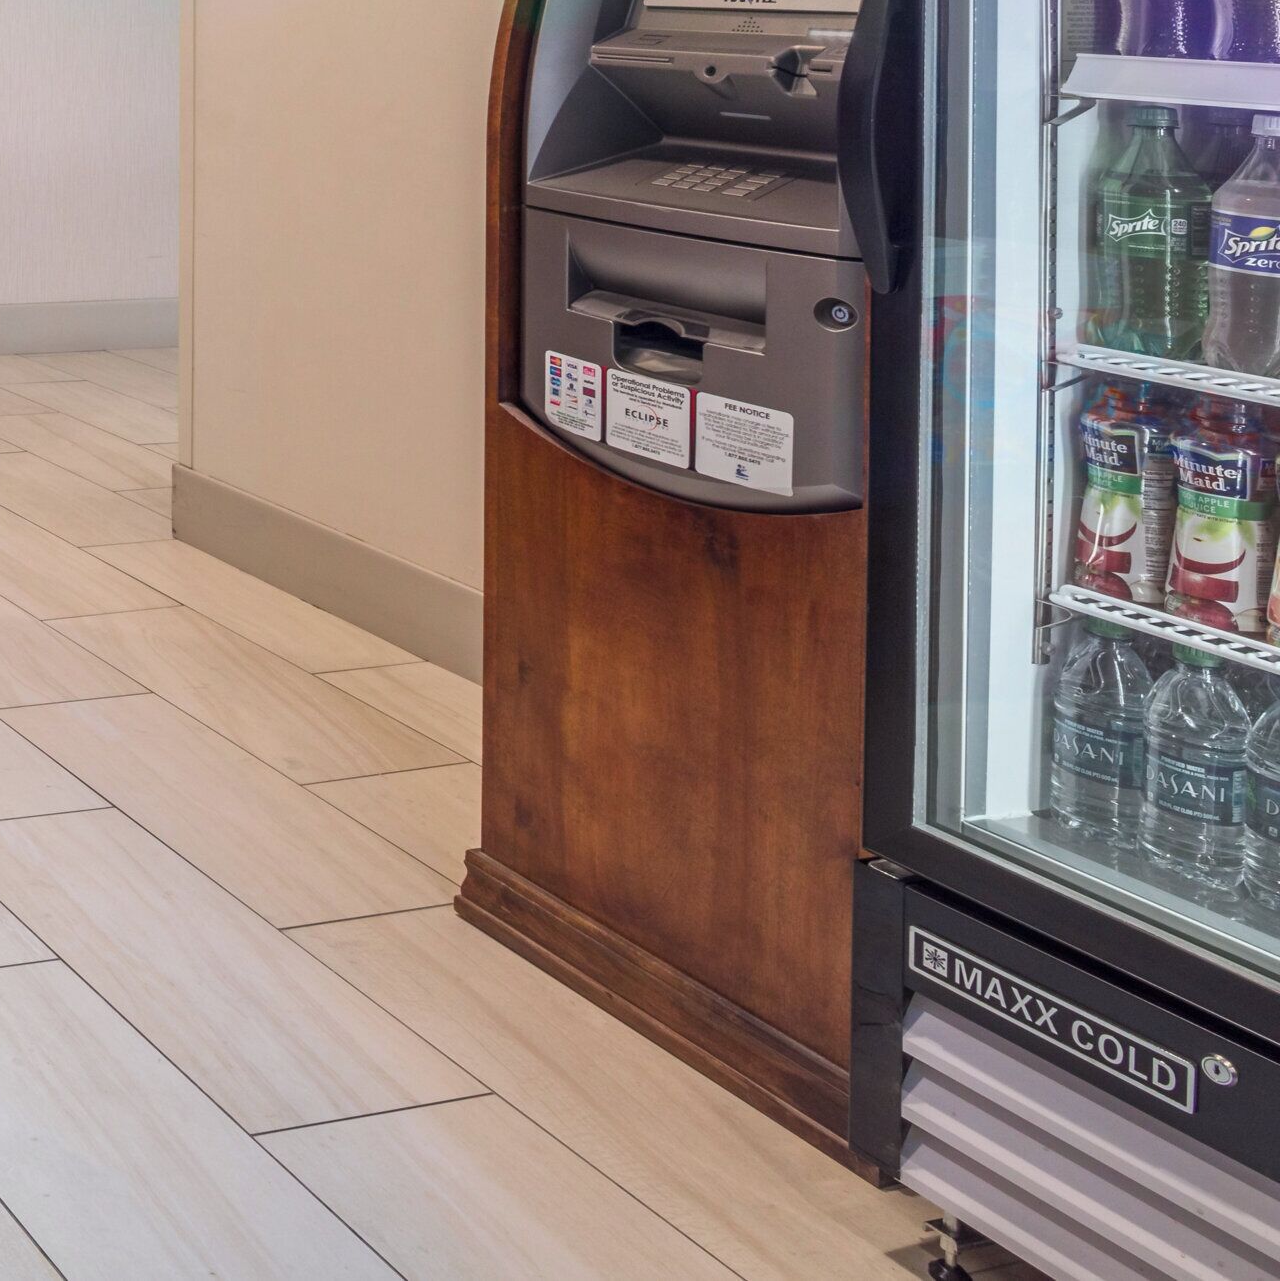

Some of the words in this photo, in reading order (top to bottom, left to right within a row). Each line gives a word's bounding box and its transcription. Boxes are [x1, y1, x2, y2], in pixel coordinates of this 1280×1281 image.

[1109, 218, 1160, 239] Sprite
[1173, 220, 1188, 229] 240
[566, 362, 578, 370] VISA
[611, 372, 652, 390] Operational
[652, 385, 686, 399] Problems
[620, 383, 655, 398] Suspicious
[656, 393, 685, 406] Activity
[624, 407, 670, 428] ECLIPSE
[724, 402, 737, 412] FEE
[739, 406, 771, 420] NOTICE
[1173, 453, 1239, 480] Minute
[1179, 468, 1227, 492] Maid
[1198, 496, 1230, 509] APPLE
[1146, 765, 1226, 804] DASANI
[954, 957, 1059, 1037] MAXX
[1071, 1019, 1178, 1092] COLD
